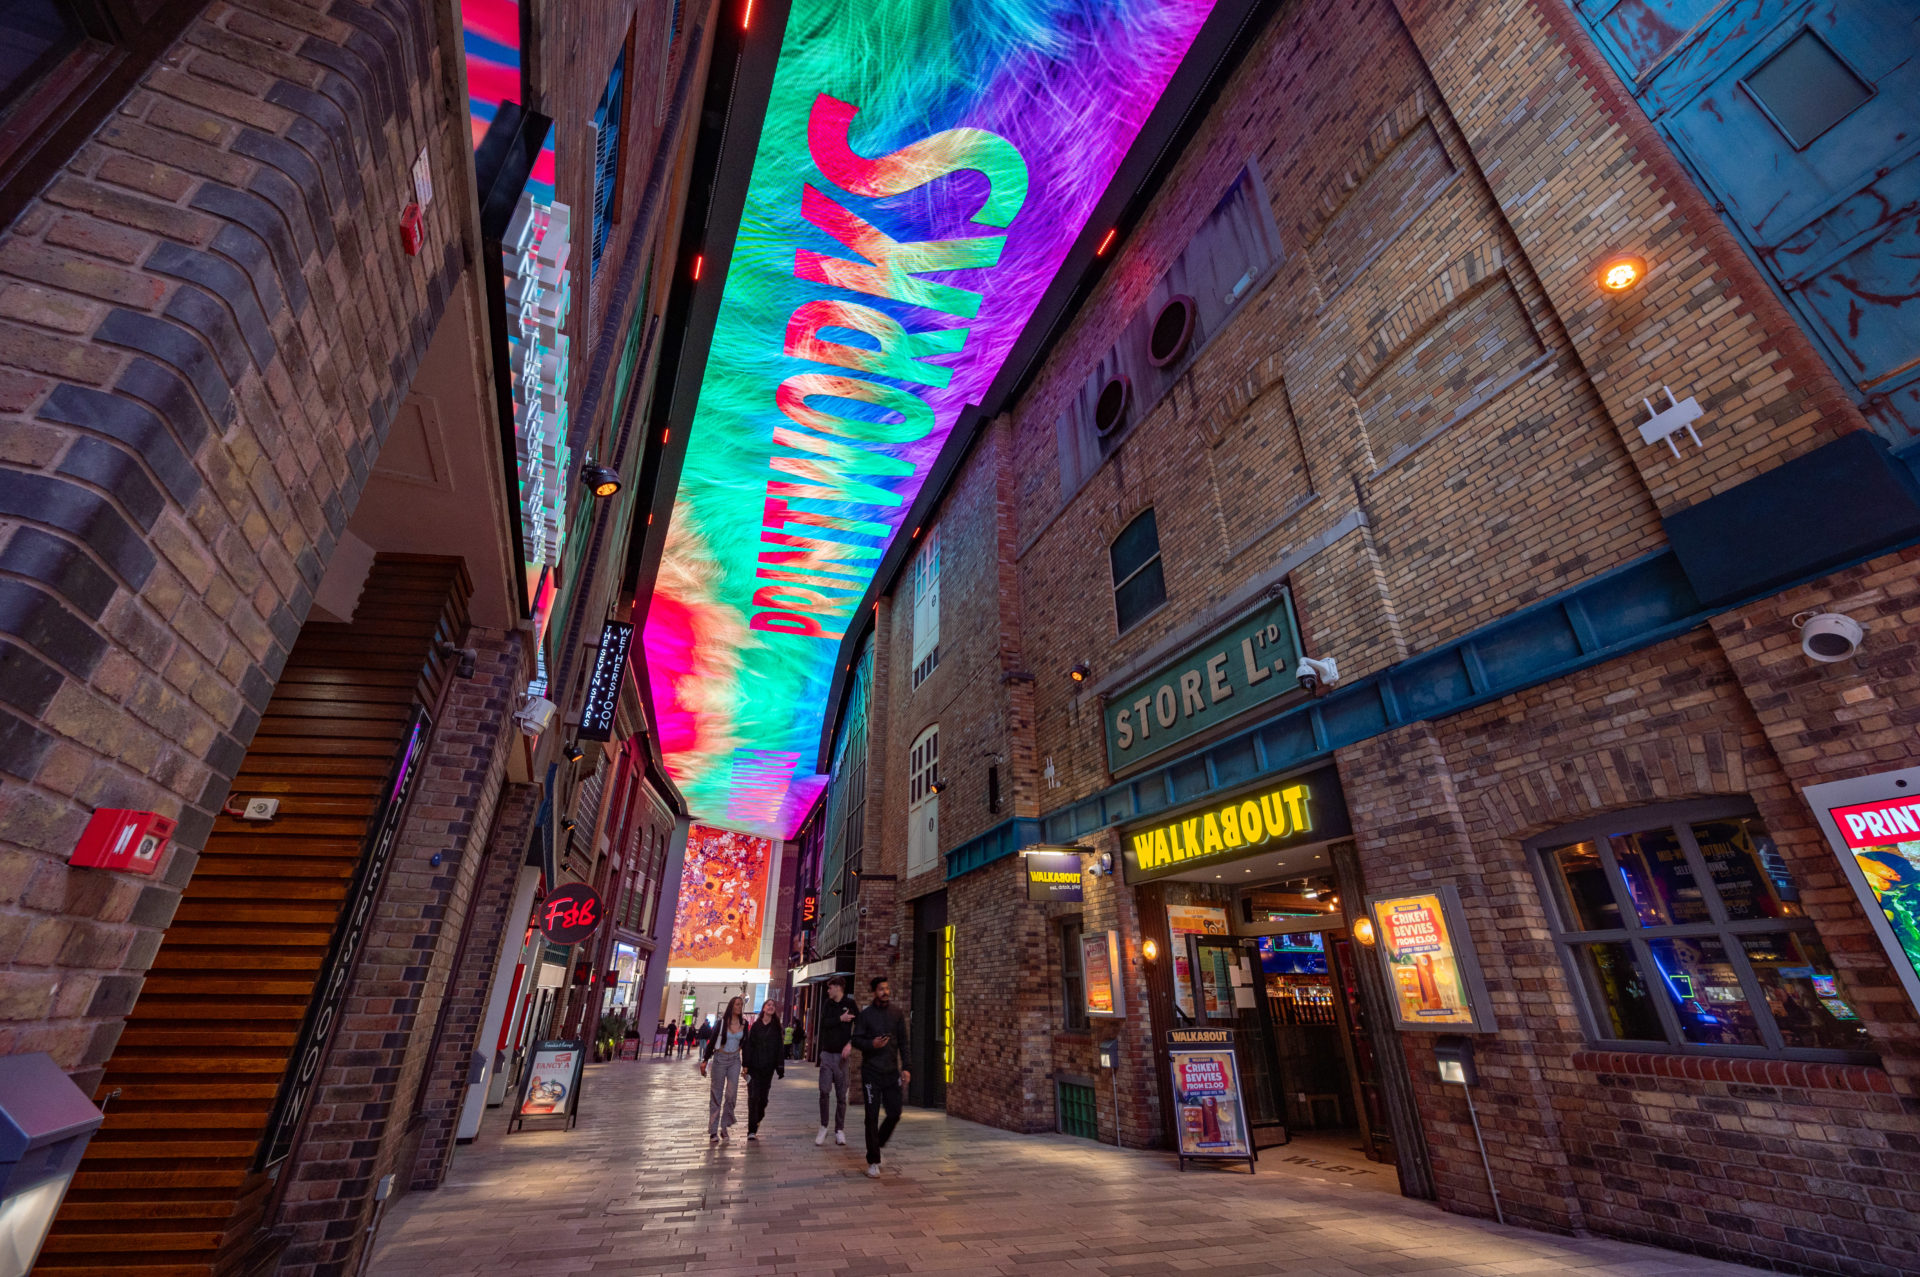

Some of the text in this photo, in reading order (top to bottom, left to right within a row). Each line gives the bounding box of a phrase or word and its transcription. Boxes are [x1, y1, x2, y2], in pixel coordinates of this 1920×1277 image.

[749, 93, 1028, 639] PRINTWORKS
[583, 625, 613, 727] THE SEVEN STARS
[599, 626, 632, 730] WETHERSPOON
[1116, 652, 1233, 750] STORE
[1133, 785, 1309, 870] WALKABOUT
[1030, 871, 1081, 884] WALKABOUT
[544, 897, 596, 931] F&B
[803, 896, 816, 922] vue
[1392, 911, 1429, 924] CRIKEY!
[285, 740, 424, 1127] WETHERSPOON
[1393, 923, 1434, 937] BEVVIES
[1395, 937, 1416, 946] FROM
[1171, 1031, 1227, 1042] WALKABOUT
[1185, 1062, 1220, 1073] CRIKEY!
[1185, 1072, 1223, 1082] BEVVIES
